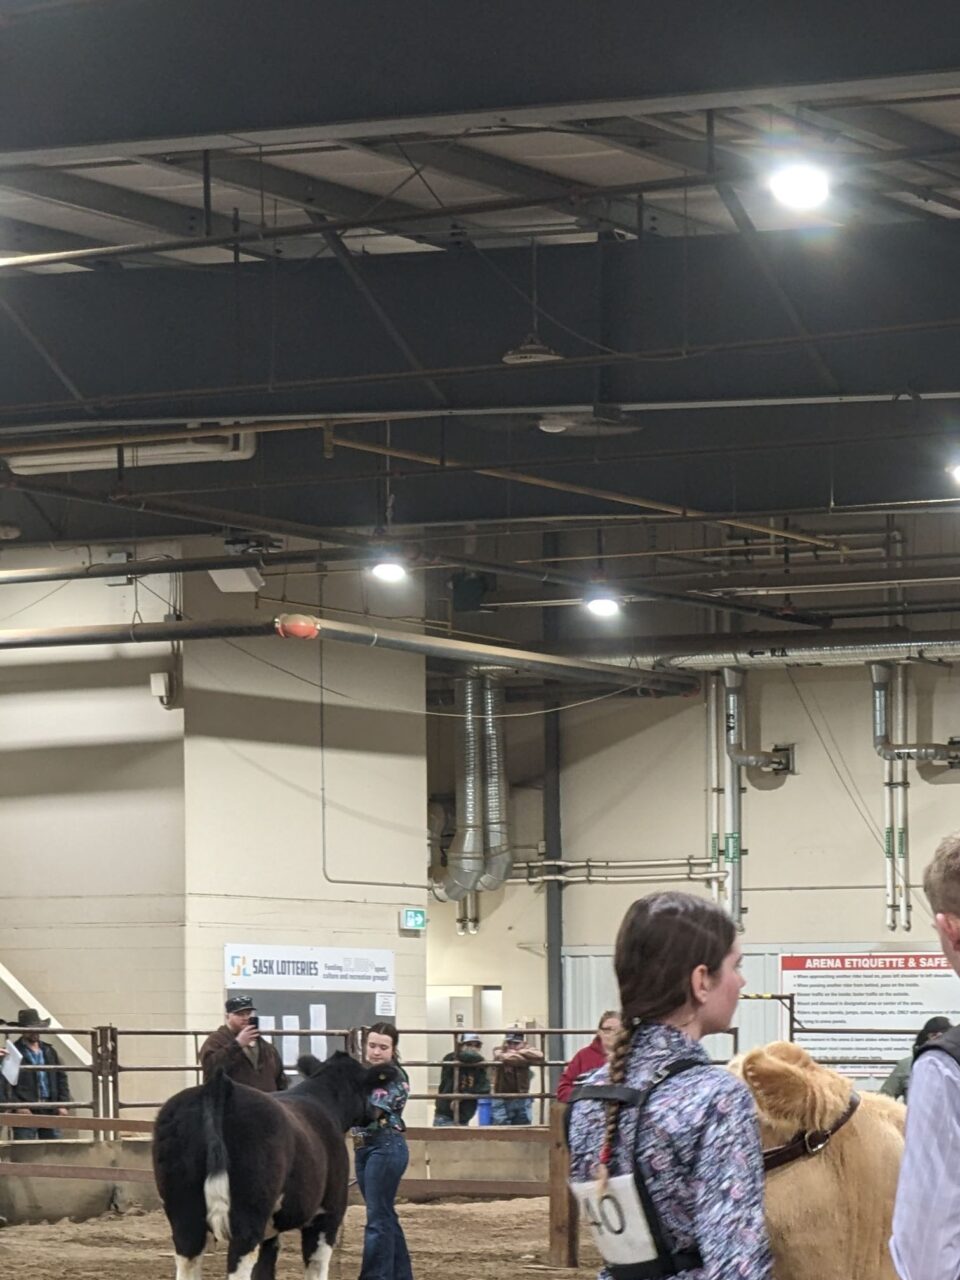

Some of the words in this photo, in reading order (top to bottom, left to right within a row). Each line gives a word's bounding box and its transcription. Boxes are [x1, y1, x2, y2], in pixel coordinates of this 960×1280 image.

[252, 959, 275, 975] SASK
[276, 960, 319, 976] LOTTERIES
[805, 958, 842, 969] ARENA
[844, 957, 905, 968] ETIQUETTE
[907, 957, 917, 968] &
[919, 957, 951, 968] SAFE
